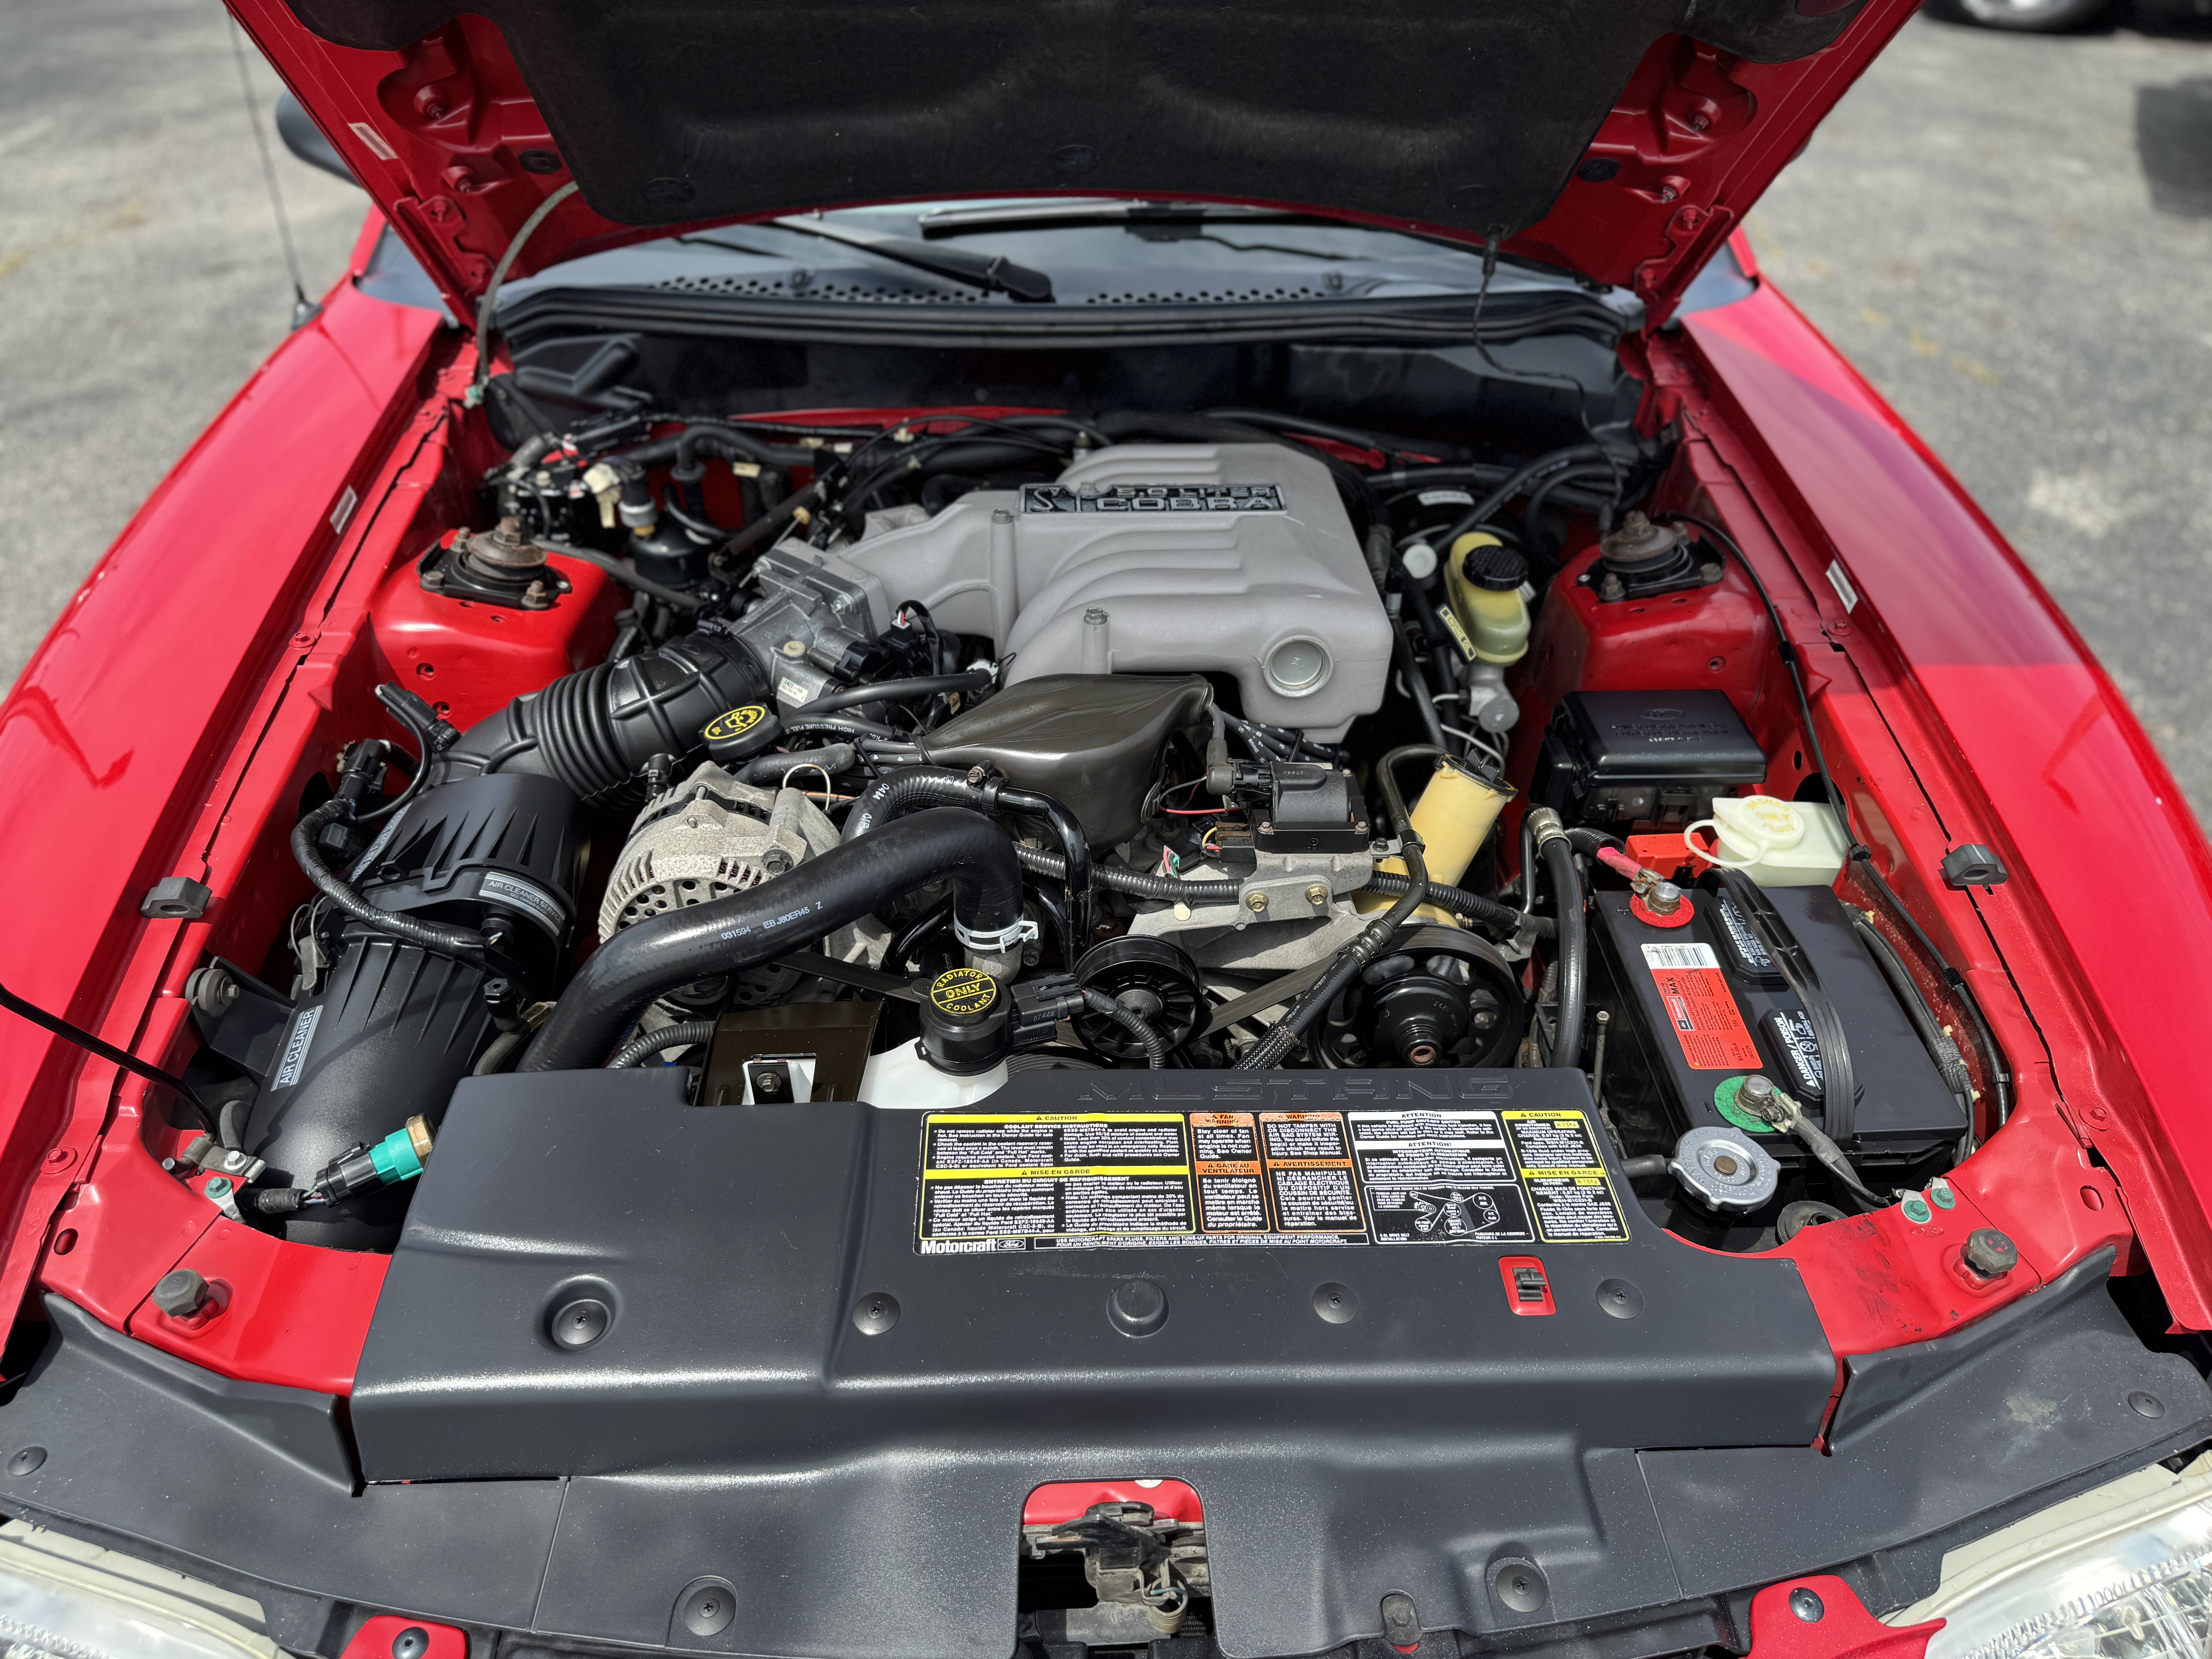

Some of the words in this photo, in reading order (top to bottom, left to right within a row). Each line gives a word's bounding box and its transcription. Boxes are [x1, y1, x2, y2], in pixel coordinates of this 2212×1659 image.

[1097, 497, 1275, 512] COBRA
[1446, 614, 1465, 640] ENGINE
[1463, 640, 1471, 653] OIL
[740, 710, 758, 723] ENGINE
[711, 726, 722, 735] OIL
[1755, 812, 1790, 821] ONLY
[505, 884, 539, 904] CLEANER
[540, 900, 562, 924] SERVICE
[520, 896, 536, 906] OWNER
[536, 905, 548, 915] GUIDE
[721, 925, 751, 940] 031594
[815, 901, 823, 910] Z
[937, 970, 983, 988] RADIATOR
[1666, 977, 1680, 994] MAX
[945, 982, 981, 999] ONLY
[946, 993, 991, 1011] COOLANT
[1774, 1017, 1794, 1043] POISON
[279, 1064, 295, 1083] AIR
[287, 1009, 315, 1062] CLEANER
[1790, 1049, 1812, 1079] DANGER
[1077, 1074, 1516, 1102] MUSTANG
[921, 1238, 996, 1254] Motorcraft
